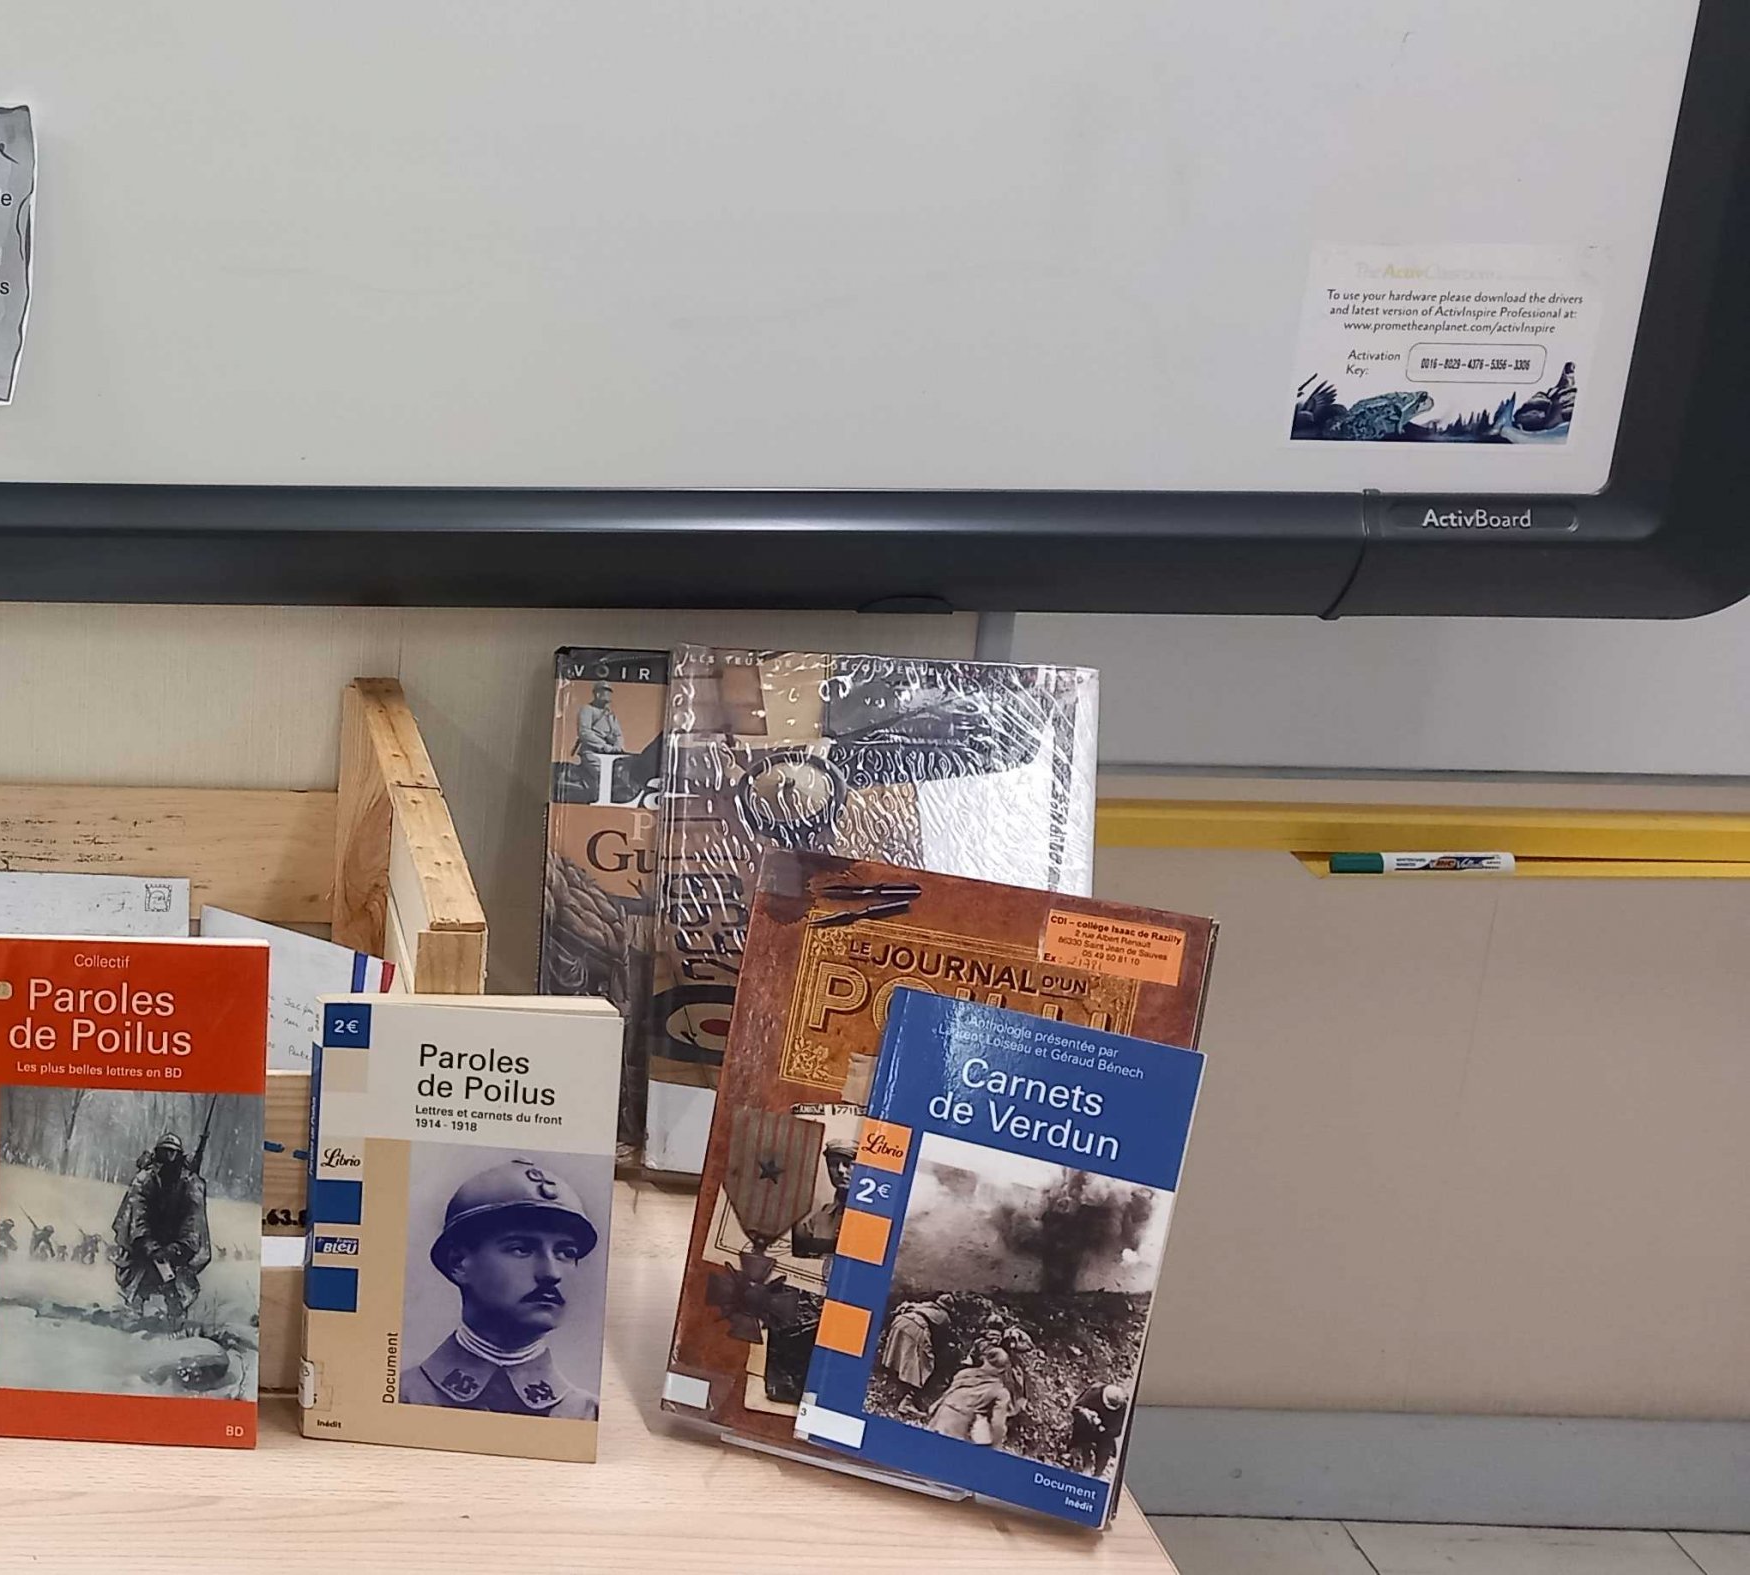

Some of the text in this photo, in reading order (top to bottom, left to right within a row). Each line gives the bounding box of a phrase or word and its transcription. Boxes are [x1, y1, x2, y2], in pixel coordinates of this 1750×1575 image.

[1327, 289, 1340, 300] To
[1362, 294, 1386, 303] your
[1389, 290, 1437, 301] hardware
[1439, 291, 1471, 304] please
[1474, 292, 1526, 302] download
[1529, 293, 1545, 303] the
[1548, 293, 1583, 304] drivers
[1330, 304, 1349, 314] and
[1352, 304, 1379, 315] latest
[1421, 306, 1434, 316] of
[1434, 306, 1496, 320] ActivInspire
[1500, 307, 1561, 318] Professional
[1348, 350, 1400, 360] Activation
[1346, 364, 1369, 378] Key:
[1422, 509, 1530, 528] ActivBoard
[75, 954, 130, 968] Collectif
[849, 939, 1088, 996] LE JOURNAL D'UN
[30, 979, 173, 1016] Paroles
[10, 1017, 190, 1055] de Poilus
[335, 1020, 358, 1033] 2€
[970, 1015, 1118, 1058] Anthologie présentée par
[420, 1044, 529, 1074] Paroles
[986, 1035, 1143, 1079] Loiseau et Géraud Bénech
[18, 1062, 36, 1072] Les
[41, 1063, 65, 1074] plus
[69, 1064, 102, 1075] belles
[107, 1066, 142, 1076] lettres
[165, 1068, 181, 1078] BD
[418, 1074, 554, 1105] de Poilus
[962, 1058, 1102, 1116] Carnets
[416, 1105, 562, 1125] Lettres et carnets du front
[416, 1119, 477, 1131] 1914 1918
[930, 1091, 1118, 1160] de Verdun
[861, 1133, 903, 1157] Librio
[321, 1148, 360, 1167] Librio
[856, 1178, 890, 1203] 2€
[382, 1333, 398, 1403] Document
[226, 1426, 243, 1437] BD
[317, 1420, 341, 1428] Inédit
[1035, 1473, 1096, 1499] Document
[1065, 1497, 1092, 1512] Inédit
